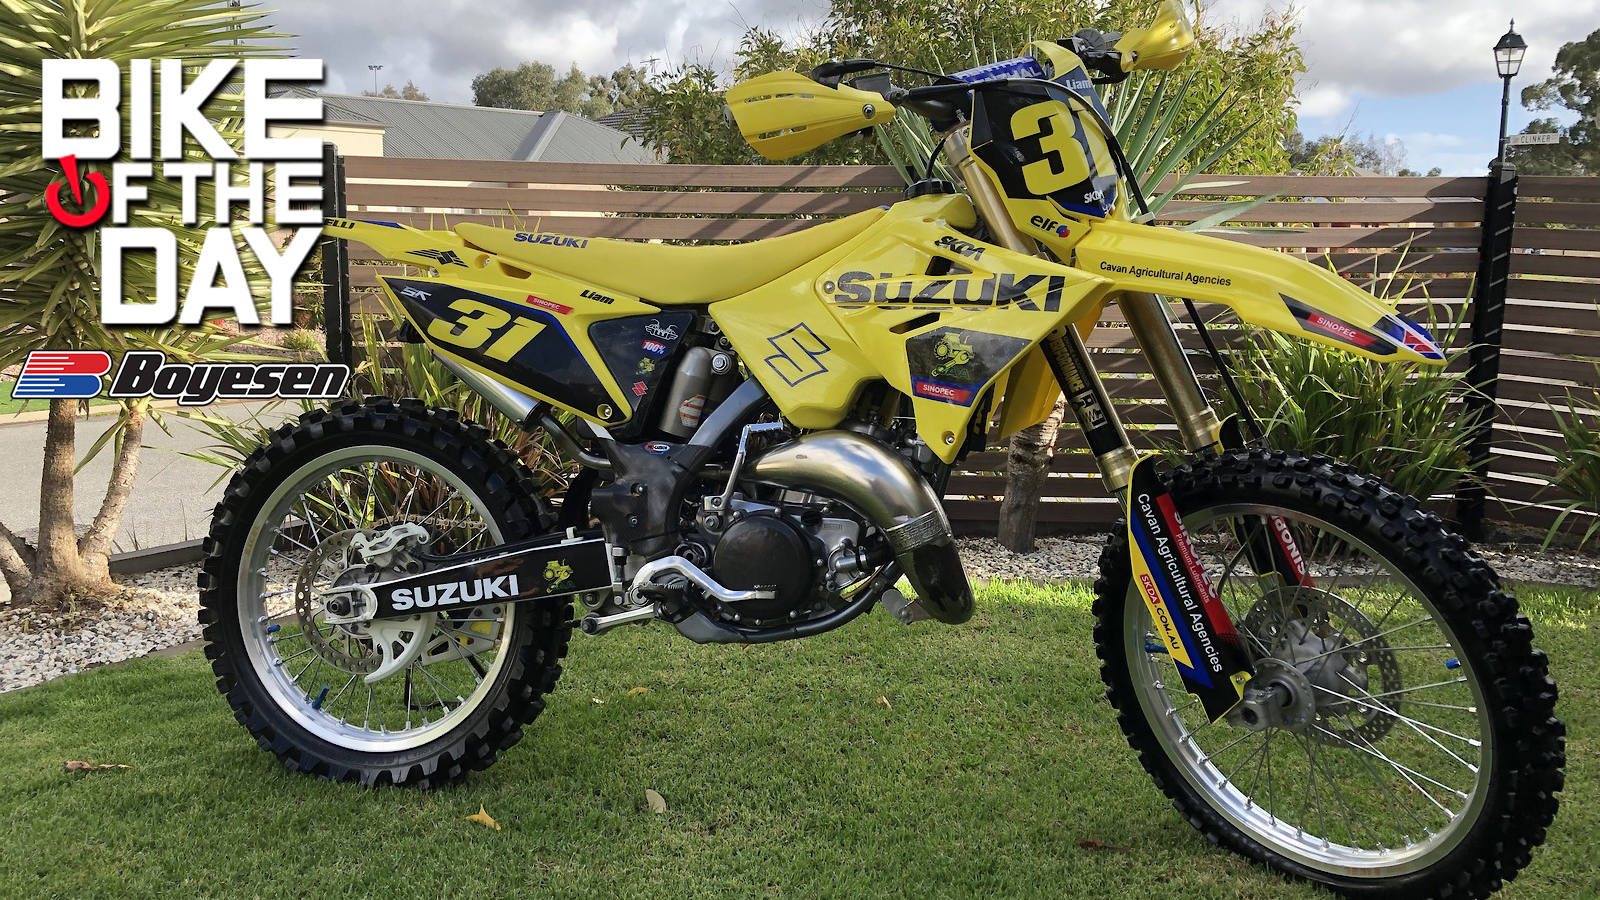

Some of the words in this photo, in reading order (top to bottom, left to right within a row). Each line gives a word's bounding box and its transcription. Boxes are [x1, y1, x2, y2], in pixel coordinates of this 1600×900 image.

[1066, 79, 1092, 91] Liam
[1010, 96, 1117, 195] 31
[1520, 134, 1551, 144] CLINKER
[323, 218, 356, 230] ELLI
[1030, 215, 1058, 232] elf
[513, 232, 589, 249] SUZUKI
[1100, 261, 1127, 274] Cavan
[1129, 265, 1184, 281] Agricultural
[1185, 272, 1232, 287] Agencies
[579, 289, 615, 305] Liam
[834, 270, 1066, 313] SUZUKI
[532, 297, 561, 310] SINOPEC
[427, 298, 547, 363] 31
[1316, 316, 1358, 339] SINOPEC
[643, 341, 666, 355] 100%
[922, 384, 955, 396] SINOPEC
[1271, 514, 1307, 576] SINOP
[1175, 533, 1193, 566] Premium
[1188, 565, 1211, 604] Lubricants
[390, 574, 520, 611] SUZUKI
[1137, 493, 1161, 535] Cavan
[1155, 536, 1198, 611] Agricultural
[1189, 612, 1223, 673] Agencies
